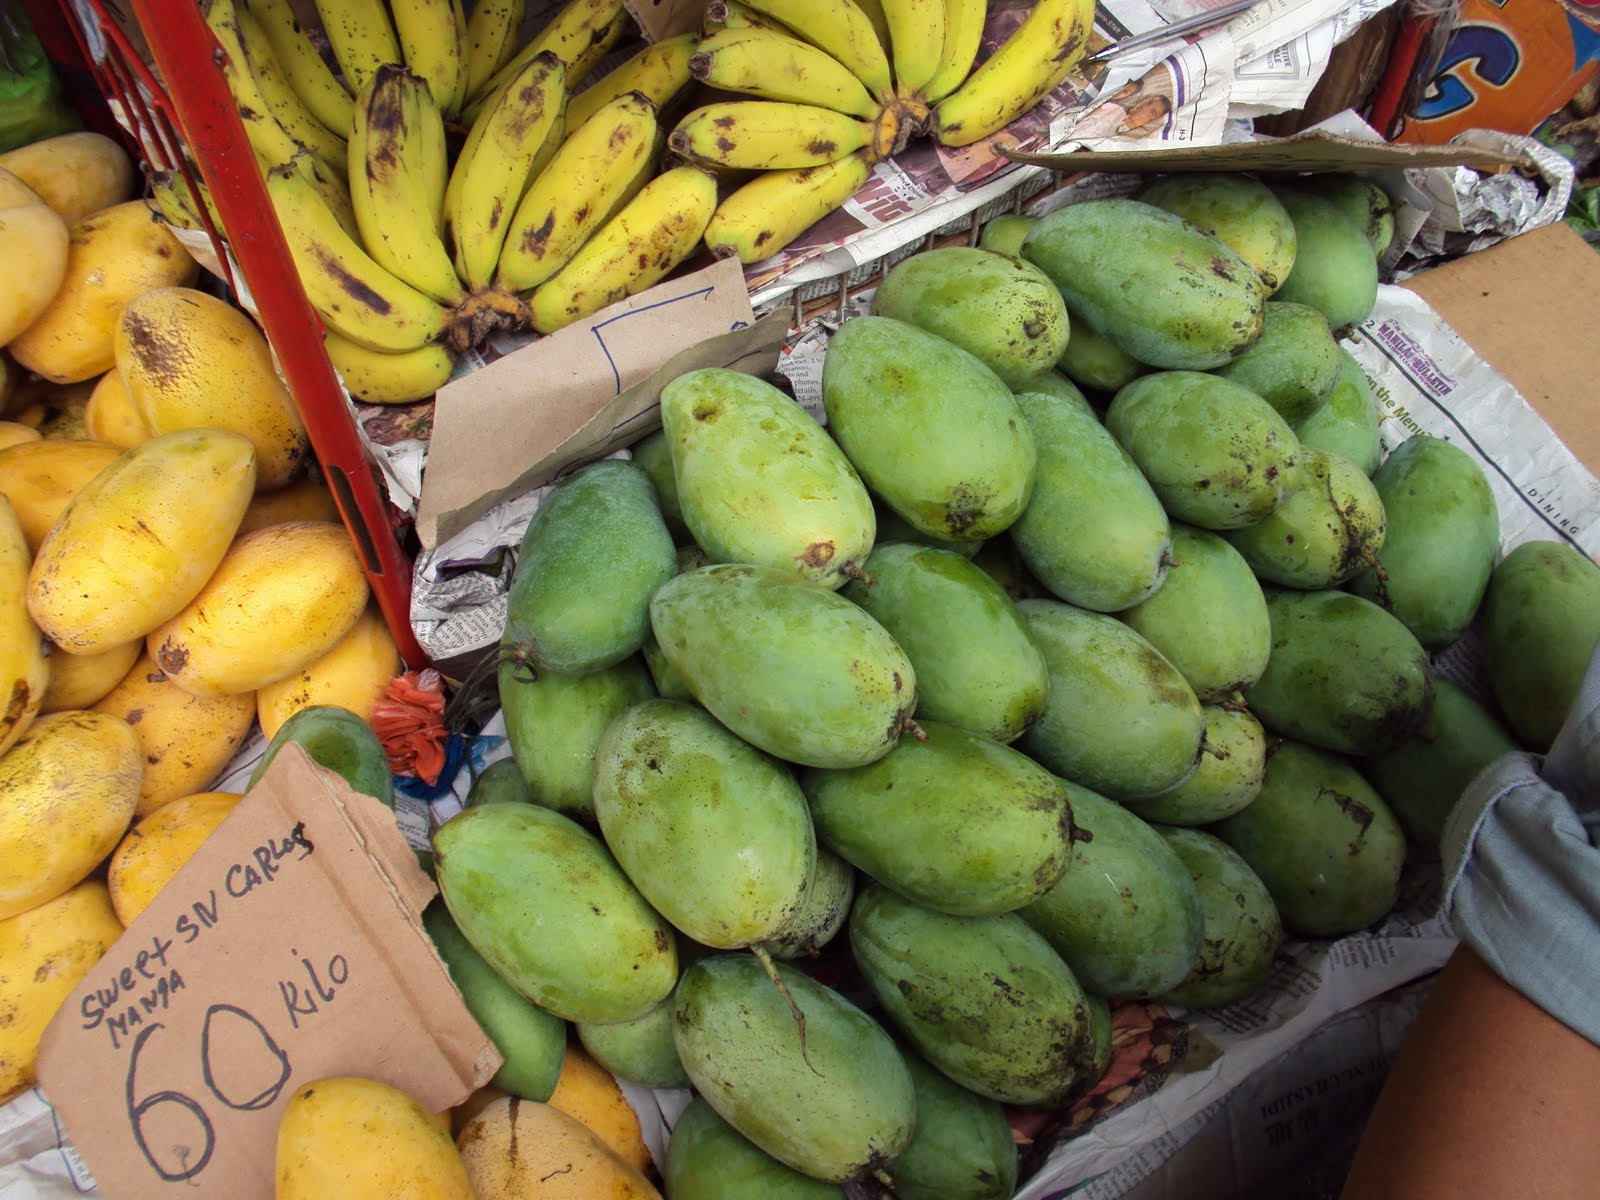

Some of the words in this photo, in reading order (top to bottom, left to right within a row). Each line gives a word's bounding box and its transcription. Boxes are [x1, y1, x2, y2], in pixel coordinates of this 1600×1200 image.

[1378, 323, 1413, 360] MANILA
[1412, 357, 1453, 396] BULLETIN
[1376, 387, 1396, 409] the
[1527, 488, 1580, 535] DINING
[81, 937, 173, 1030] Sweet
[126, 1004, 292, 1183] 60
